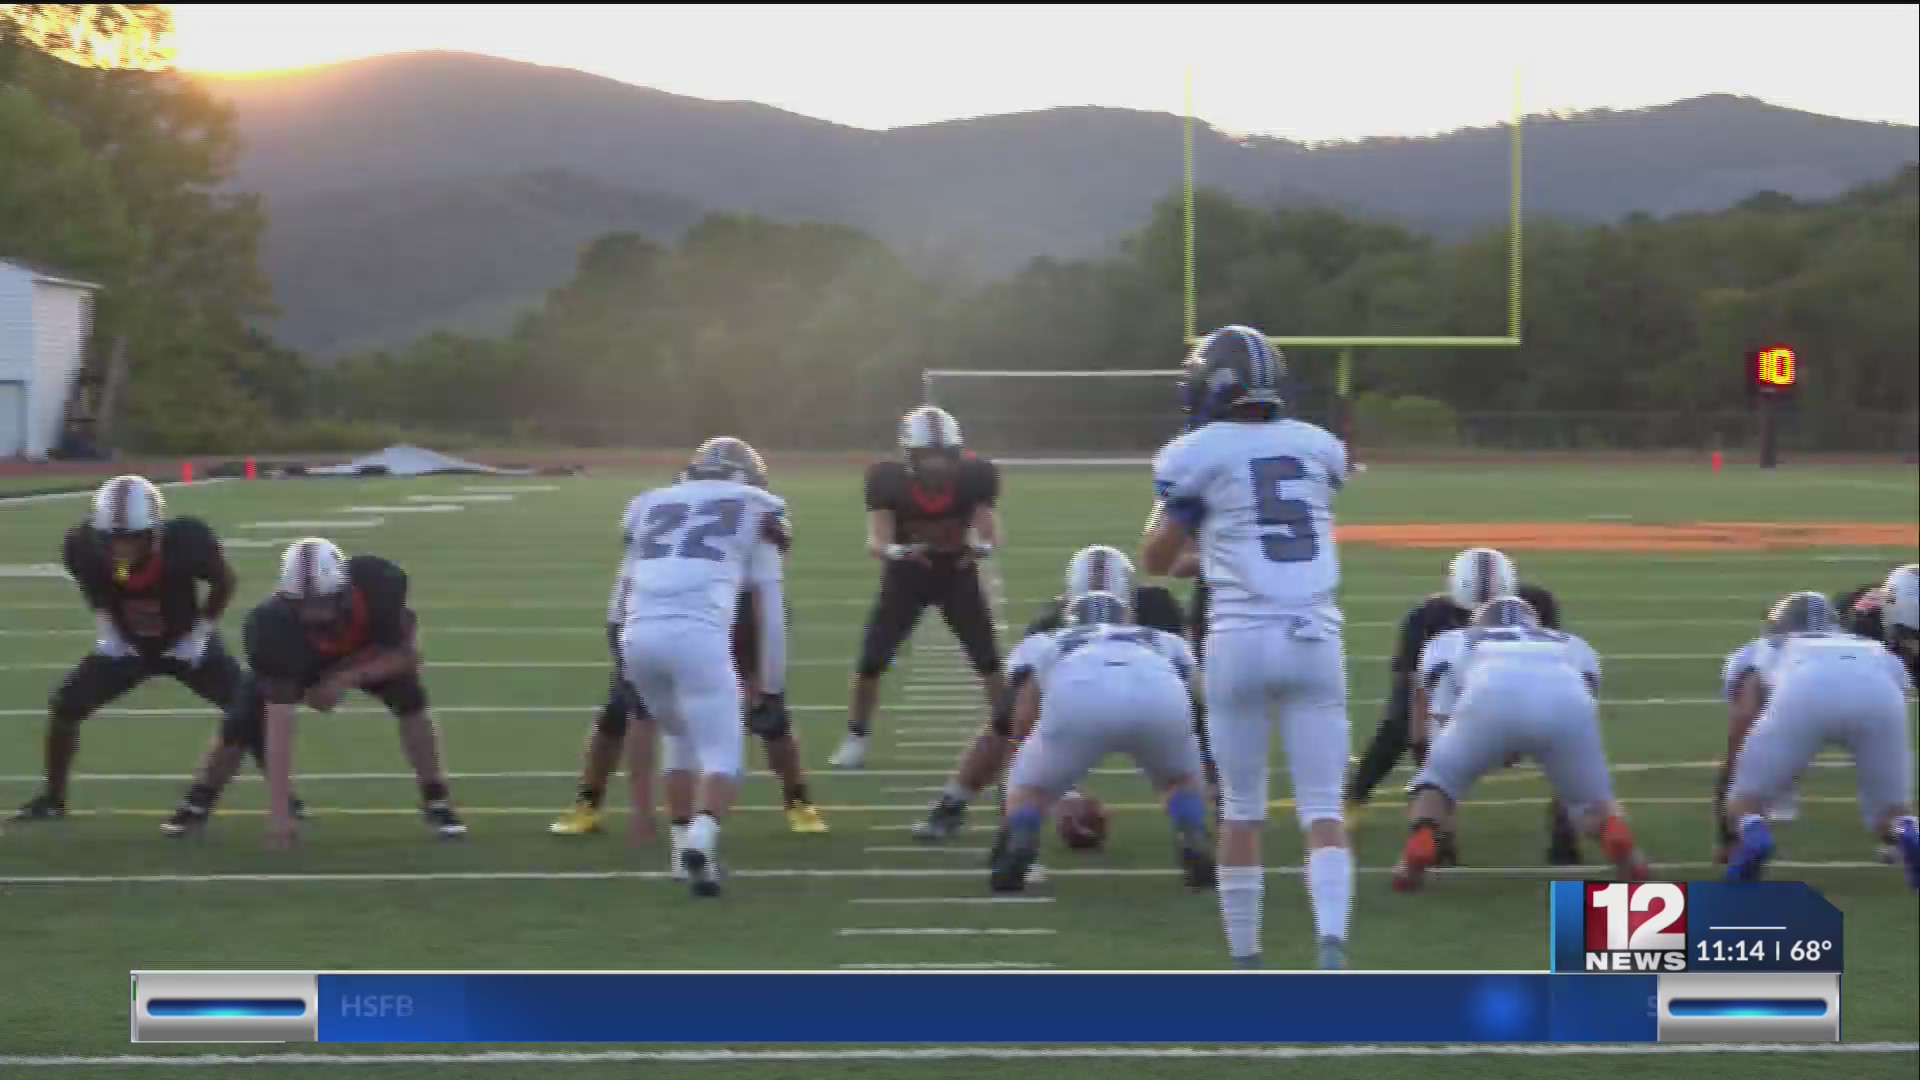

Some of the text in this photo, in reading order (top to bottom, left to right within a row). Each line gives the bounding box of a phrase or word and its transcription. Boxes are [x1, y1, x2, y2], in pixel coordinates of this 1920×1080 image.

[1757, 348, 1796, 384] 10
[640, 500, 744, 562] 22
[1249, 455, 1319, 563] 5
